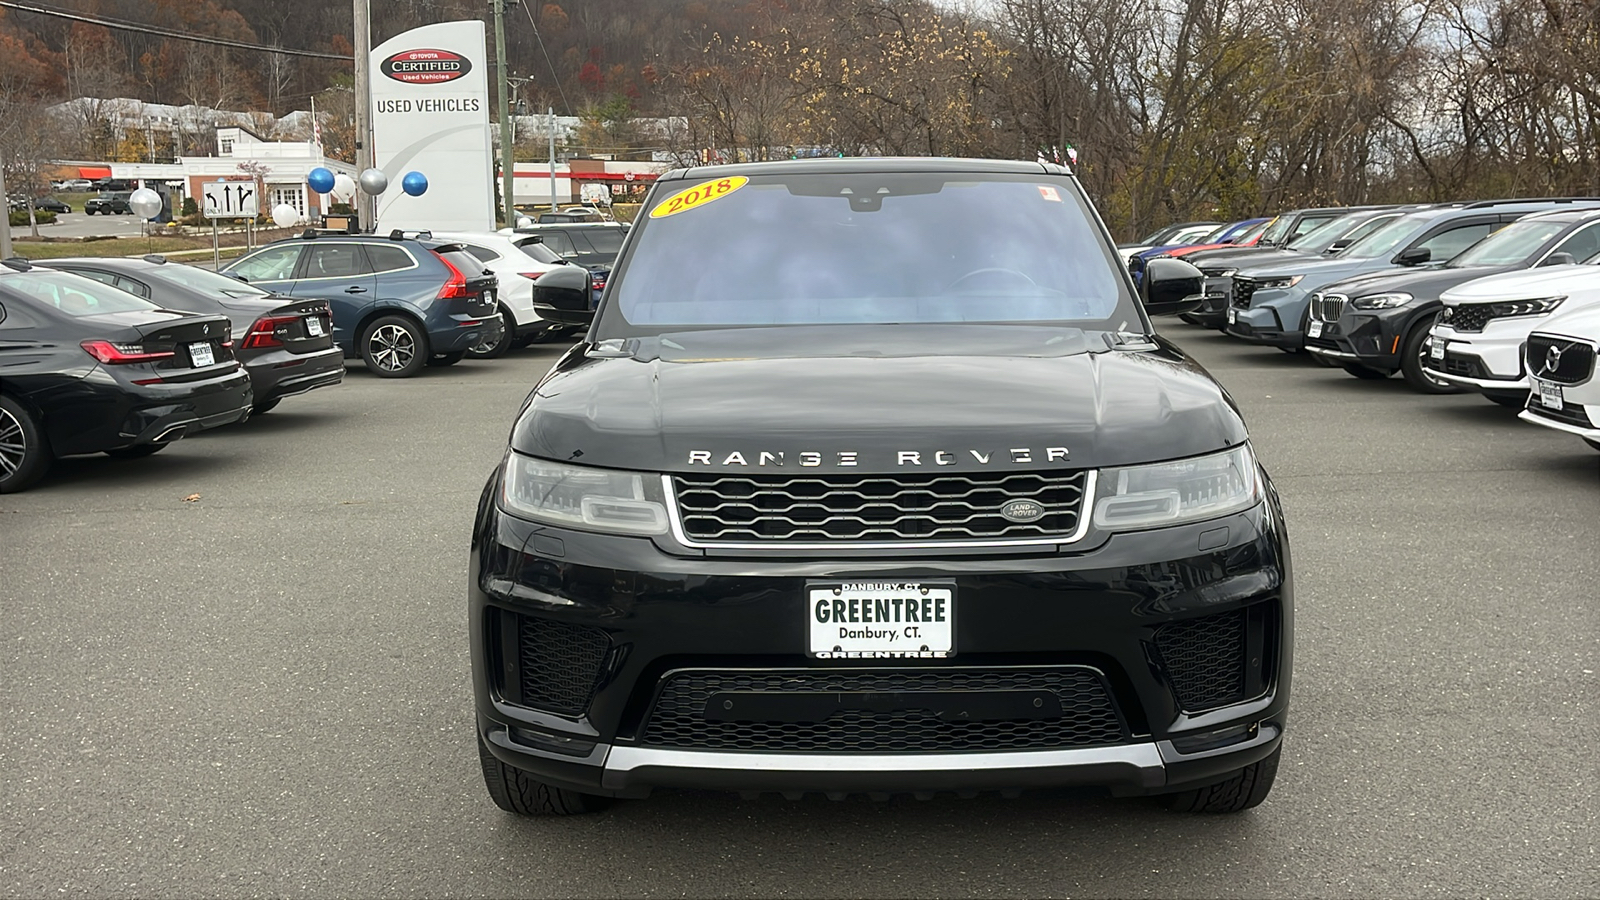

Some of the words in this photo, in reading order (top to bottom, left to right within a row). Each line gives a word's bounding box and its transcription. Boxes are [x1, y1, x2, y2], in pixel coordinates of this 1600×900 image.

[391, 61, 460, 72] CERTIFIED
[377, 100, 412, 113] USED
[416, 99, 480, 112] VEHICLES
[668, 178, 732, 213] 2018
[688, 450, 858, 467] RANGE
[897, 447, 1071, 466] ROVER
[841, 583, 901, 592] DANBURY,
[903, 583, 921, 591] CT
[815, 598, 946, 624] GREENTREE
[839, 626, 899, 642] Danbury,
[904, 626, 922, 639] CT.
[815, 651, 948, 659] GREENTREE
